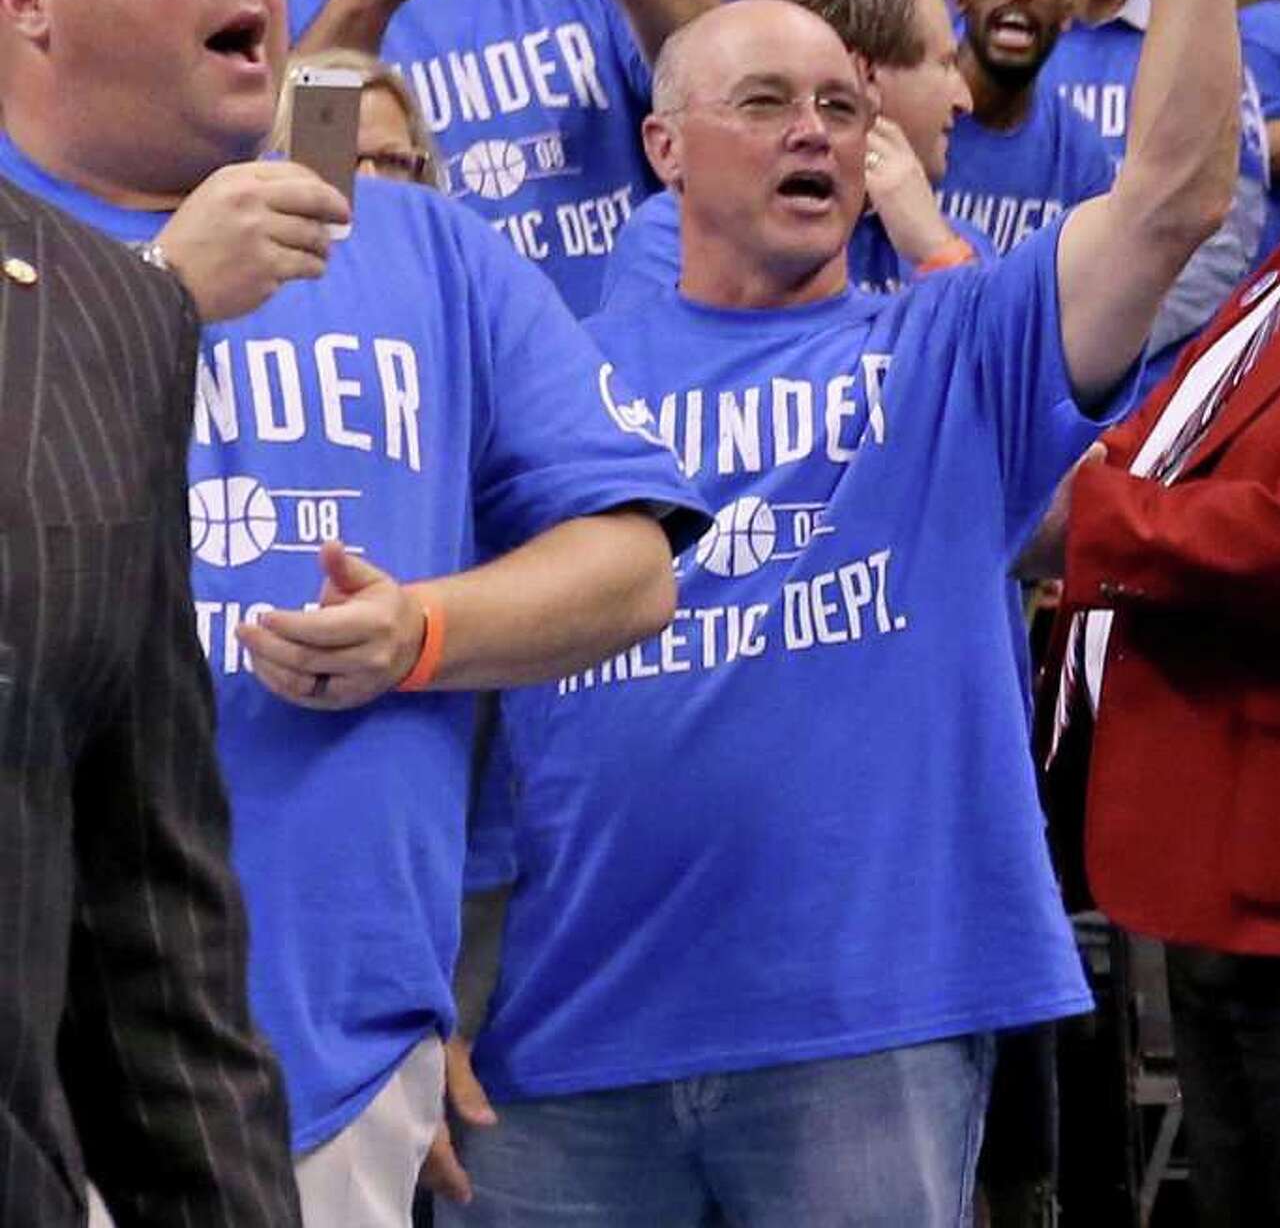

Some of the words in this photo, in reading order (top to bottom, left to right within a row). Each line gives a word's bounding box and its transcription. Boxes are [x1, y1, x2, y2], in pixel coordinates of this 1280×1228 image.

[391, 22, 609, 134] UNDER
[936, 191, 1066, 257] UNDER
[194, 332, 421, 473] NDER
[659, 353, 893, 480] UNDER
[296, 499, 340, 543] 08
[558, 603, 771, 695] LETIC
[783, 546, 907, 651] DEPT.
